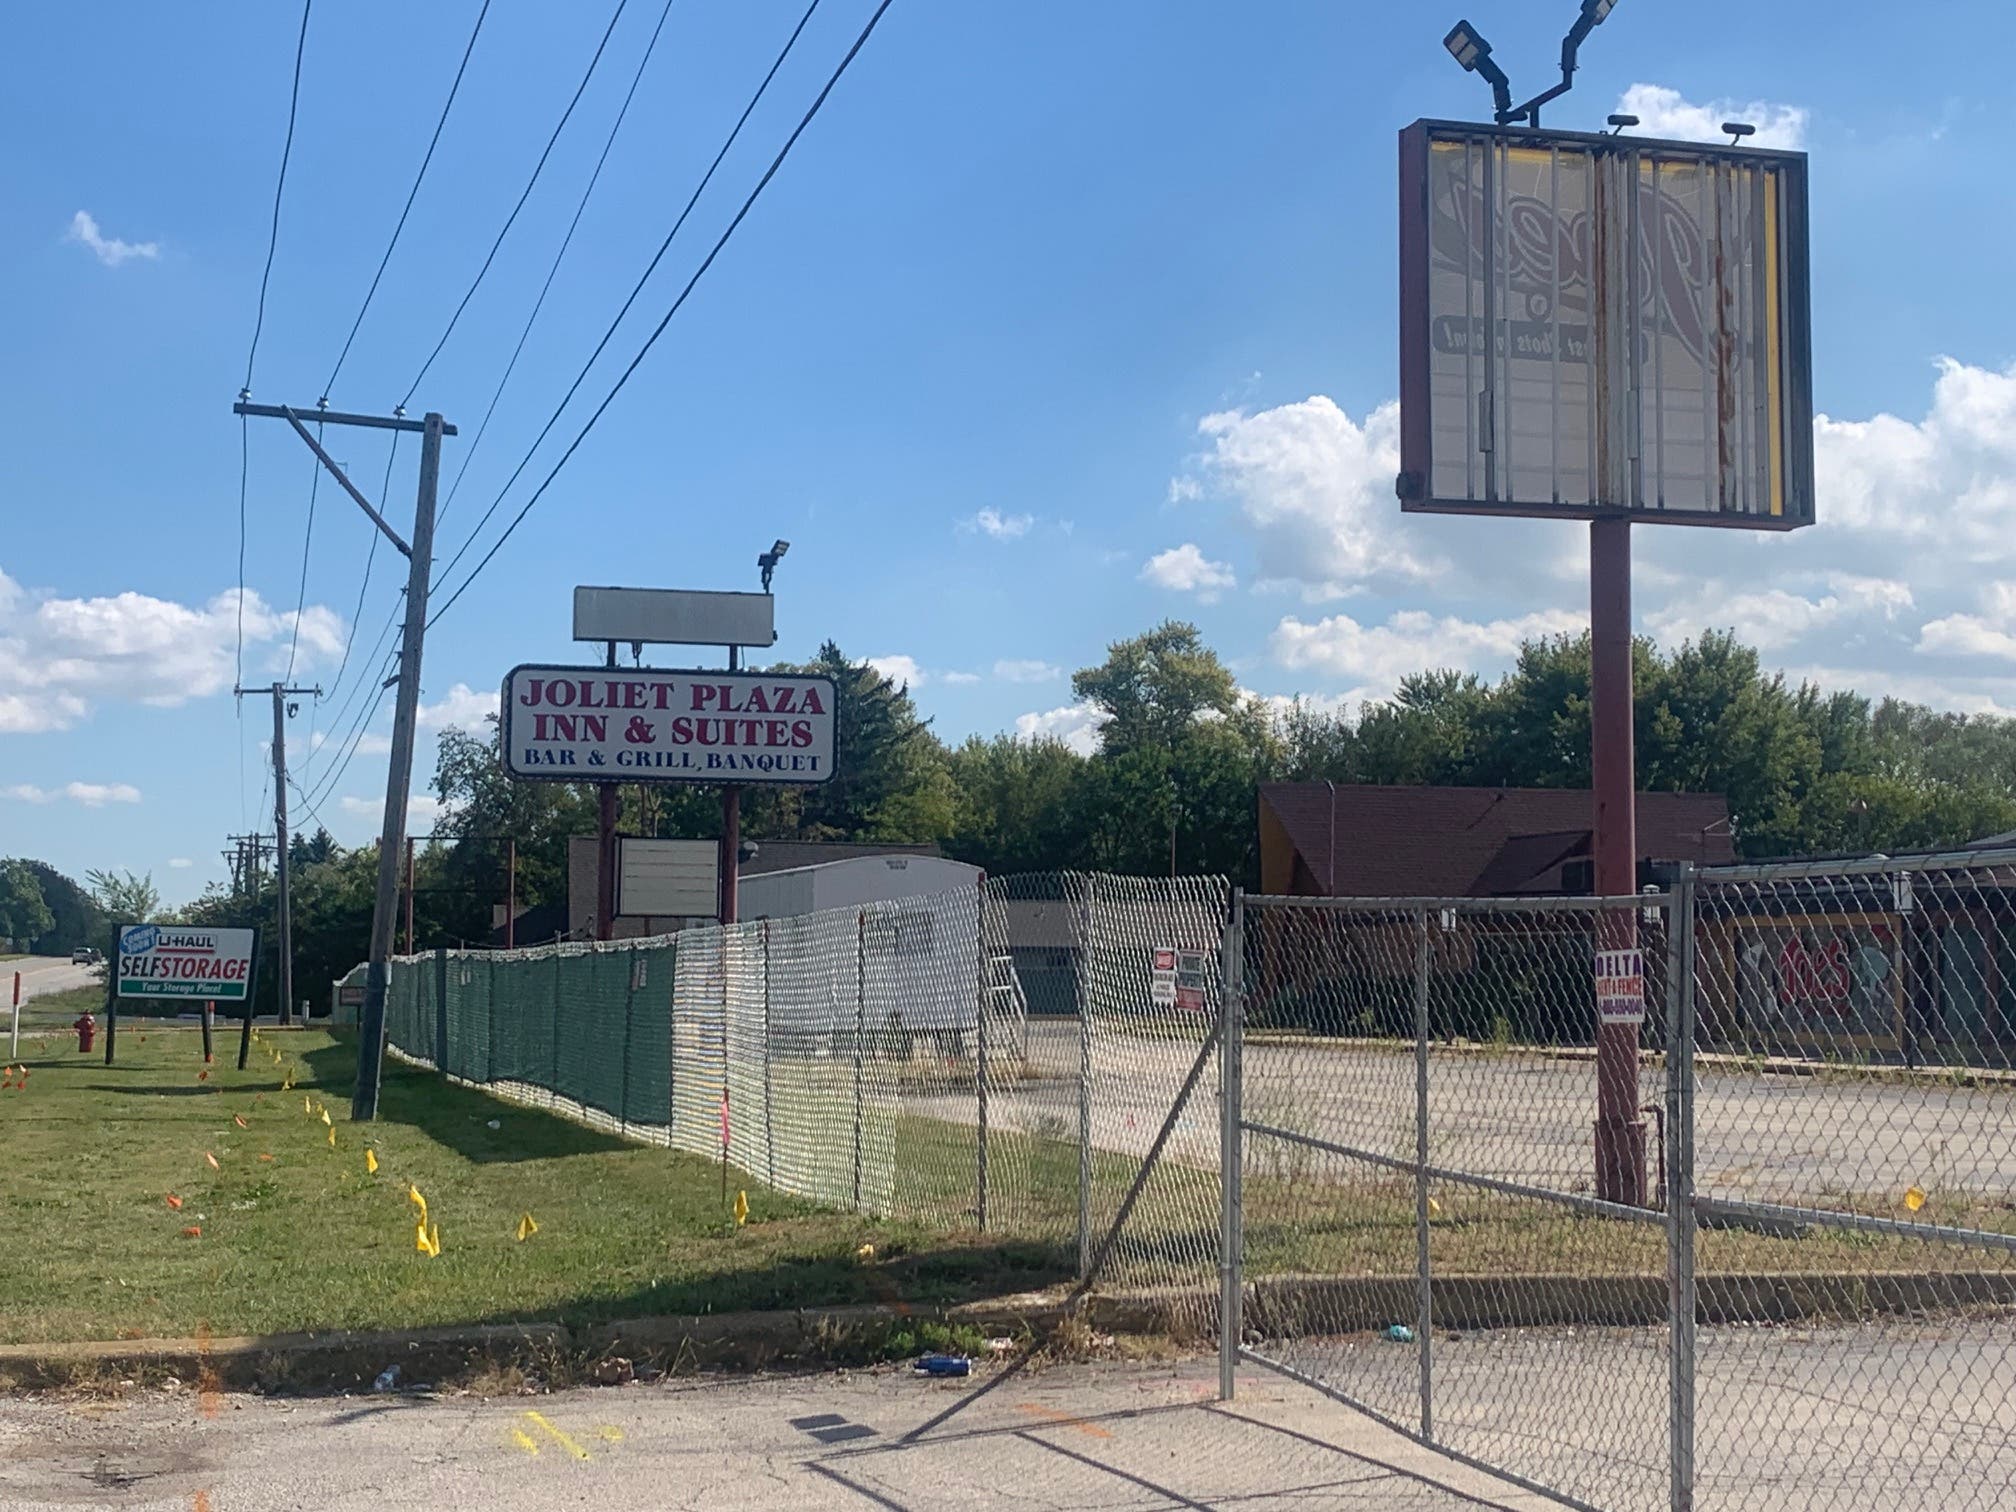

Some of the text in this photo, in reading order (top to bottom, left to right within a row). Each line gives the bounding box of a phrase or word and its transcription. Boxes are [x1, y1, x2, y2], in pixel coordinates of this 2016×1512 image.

[520, 679, 826, 715] JOLIET PLAZA
[532, 714, 813, 748] INN & SUITES
[524, 749, 577, 766] BAR
[587, 750, 606, 767] &
[707, 753, 821, 773] BANQUET
[158, 935, 214, 948] U-HAUL
[1596, 954, 1642, 977] DELTA
[142, 982, 160, 992] Your
[163, 982, 195, 995] Storage
